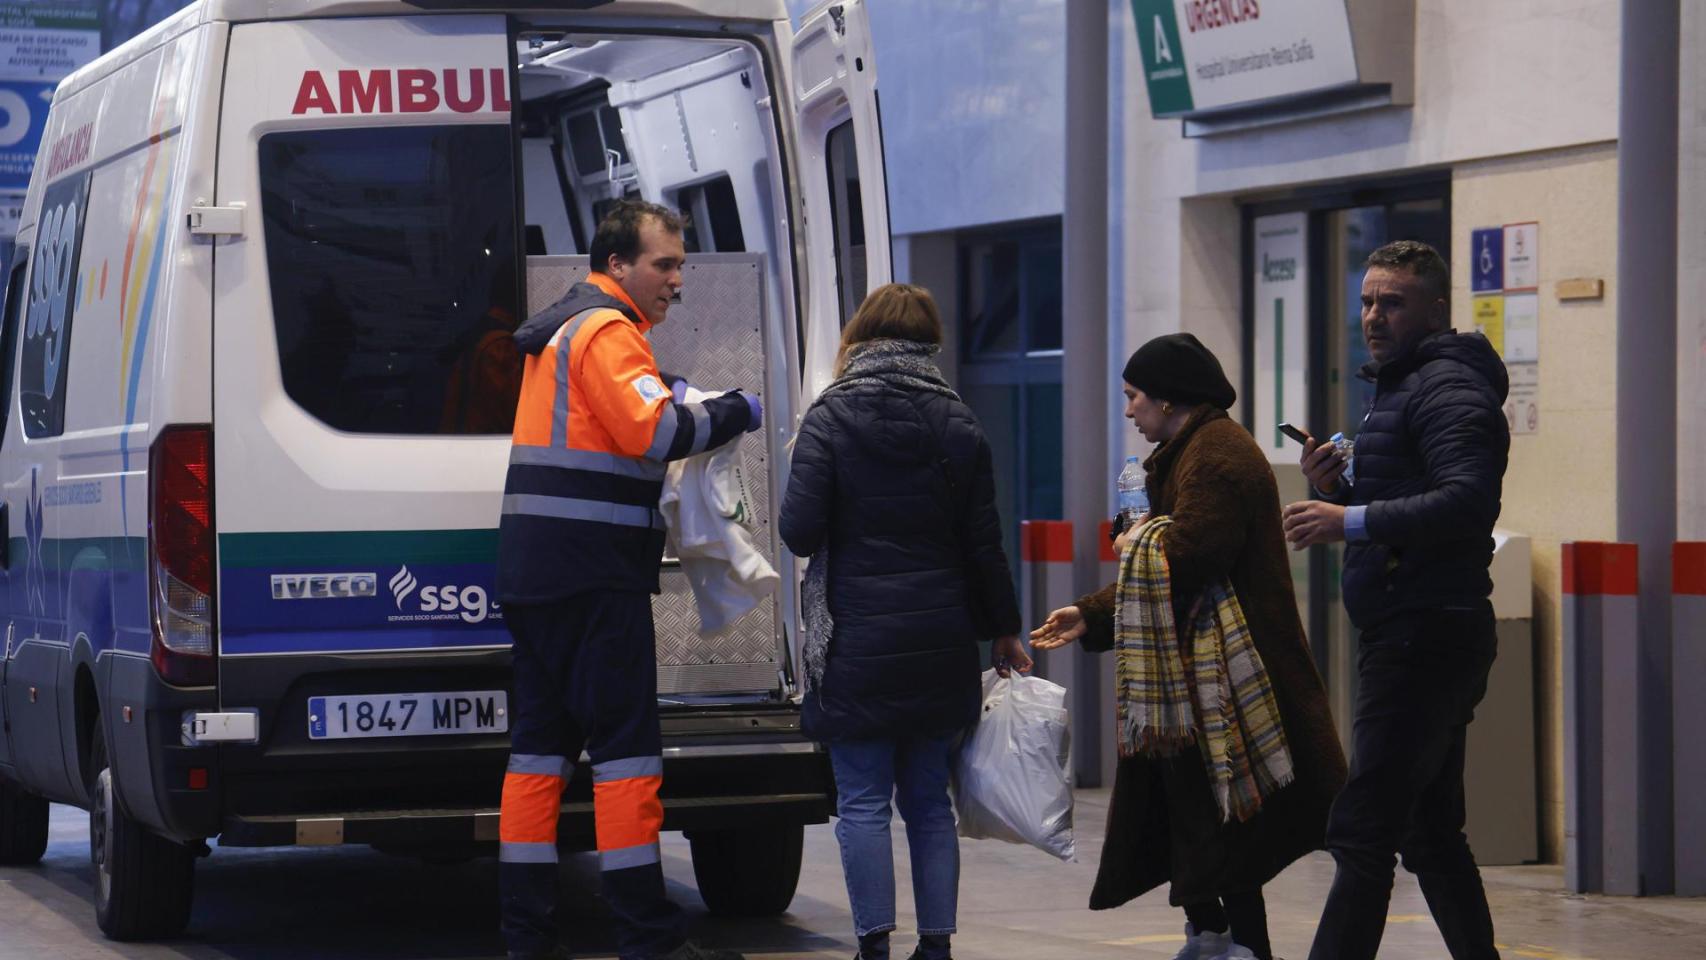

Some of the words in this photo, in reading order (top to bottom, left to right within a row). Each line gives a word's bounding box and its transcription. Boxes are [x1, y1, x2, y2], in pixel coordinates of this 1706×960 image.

[1184, 0, 1259, 32] URGENCIAS
[16, 47, 67, 56] PACIENTES
[37, 35, 88, 46] DESCANSO
[1153, 14, 1173, 63] A
[1196, 57, 1225, 83] Hospital
[1226, 51, 1272, 76] Universitario
[291, 68, 511, 114] AMBUL
[46, 121, 93, 181] AMBULANCIA
[273, 574, 376, 598] IVECO
[420, 585, 488, 624] ssg
[338, 700, 418, 732] 1847
[432, 697, 495, 729] MPM
